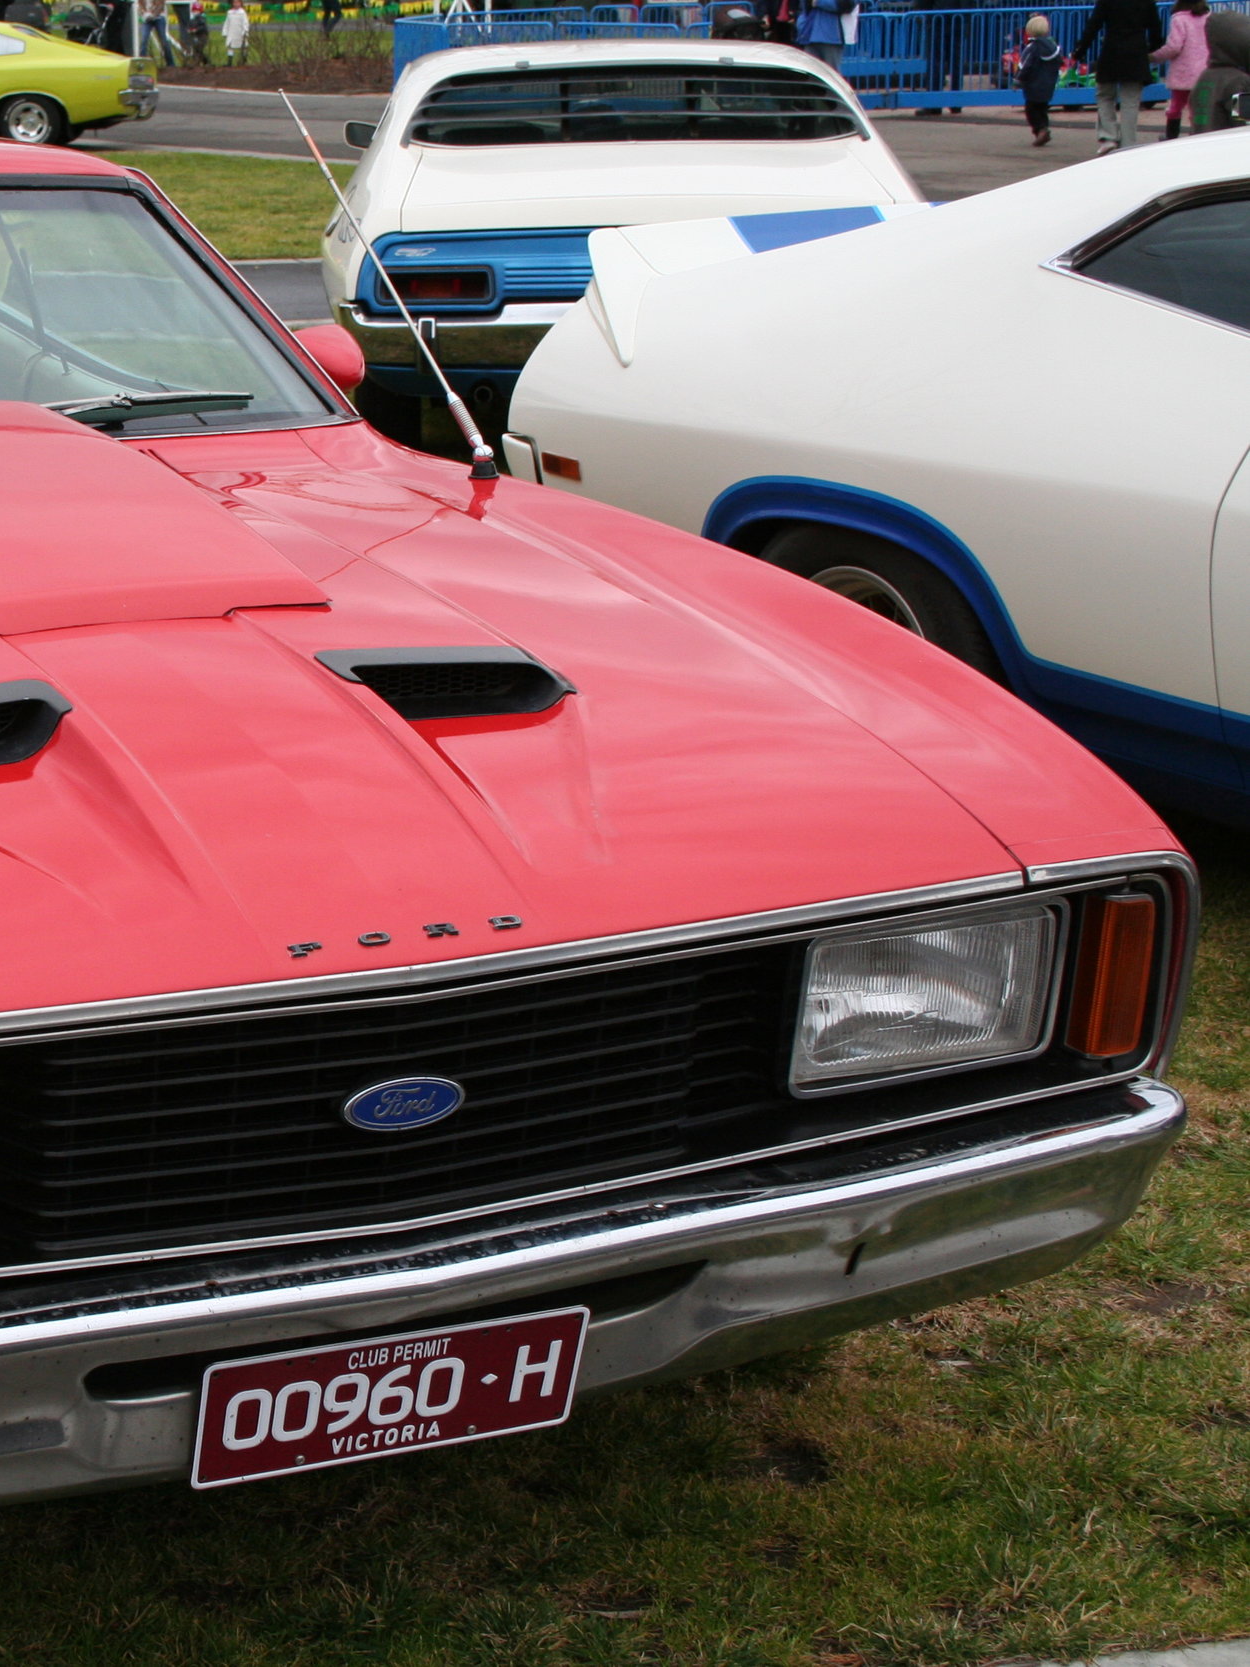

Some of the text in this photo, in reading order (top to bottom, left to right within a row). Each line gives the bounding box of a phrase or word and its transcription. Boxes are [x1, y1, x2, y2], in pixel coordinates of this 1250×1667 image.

[286, 915, 522, 958] FORD
[374, 1088, 436, 1118] Ford
[348, 1338, 451, 1370] CLUB PERMIT
[332, 1421, 440, 1455] VICTORIA
